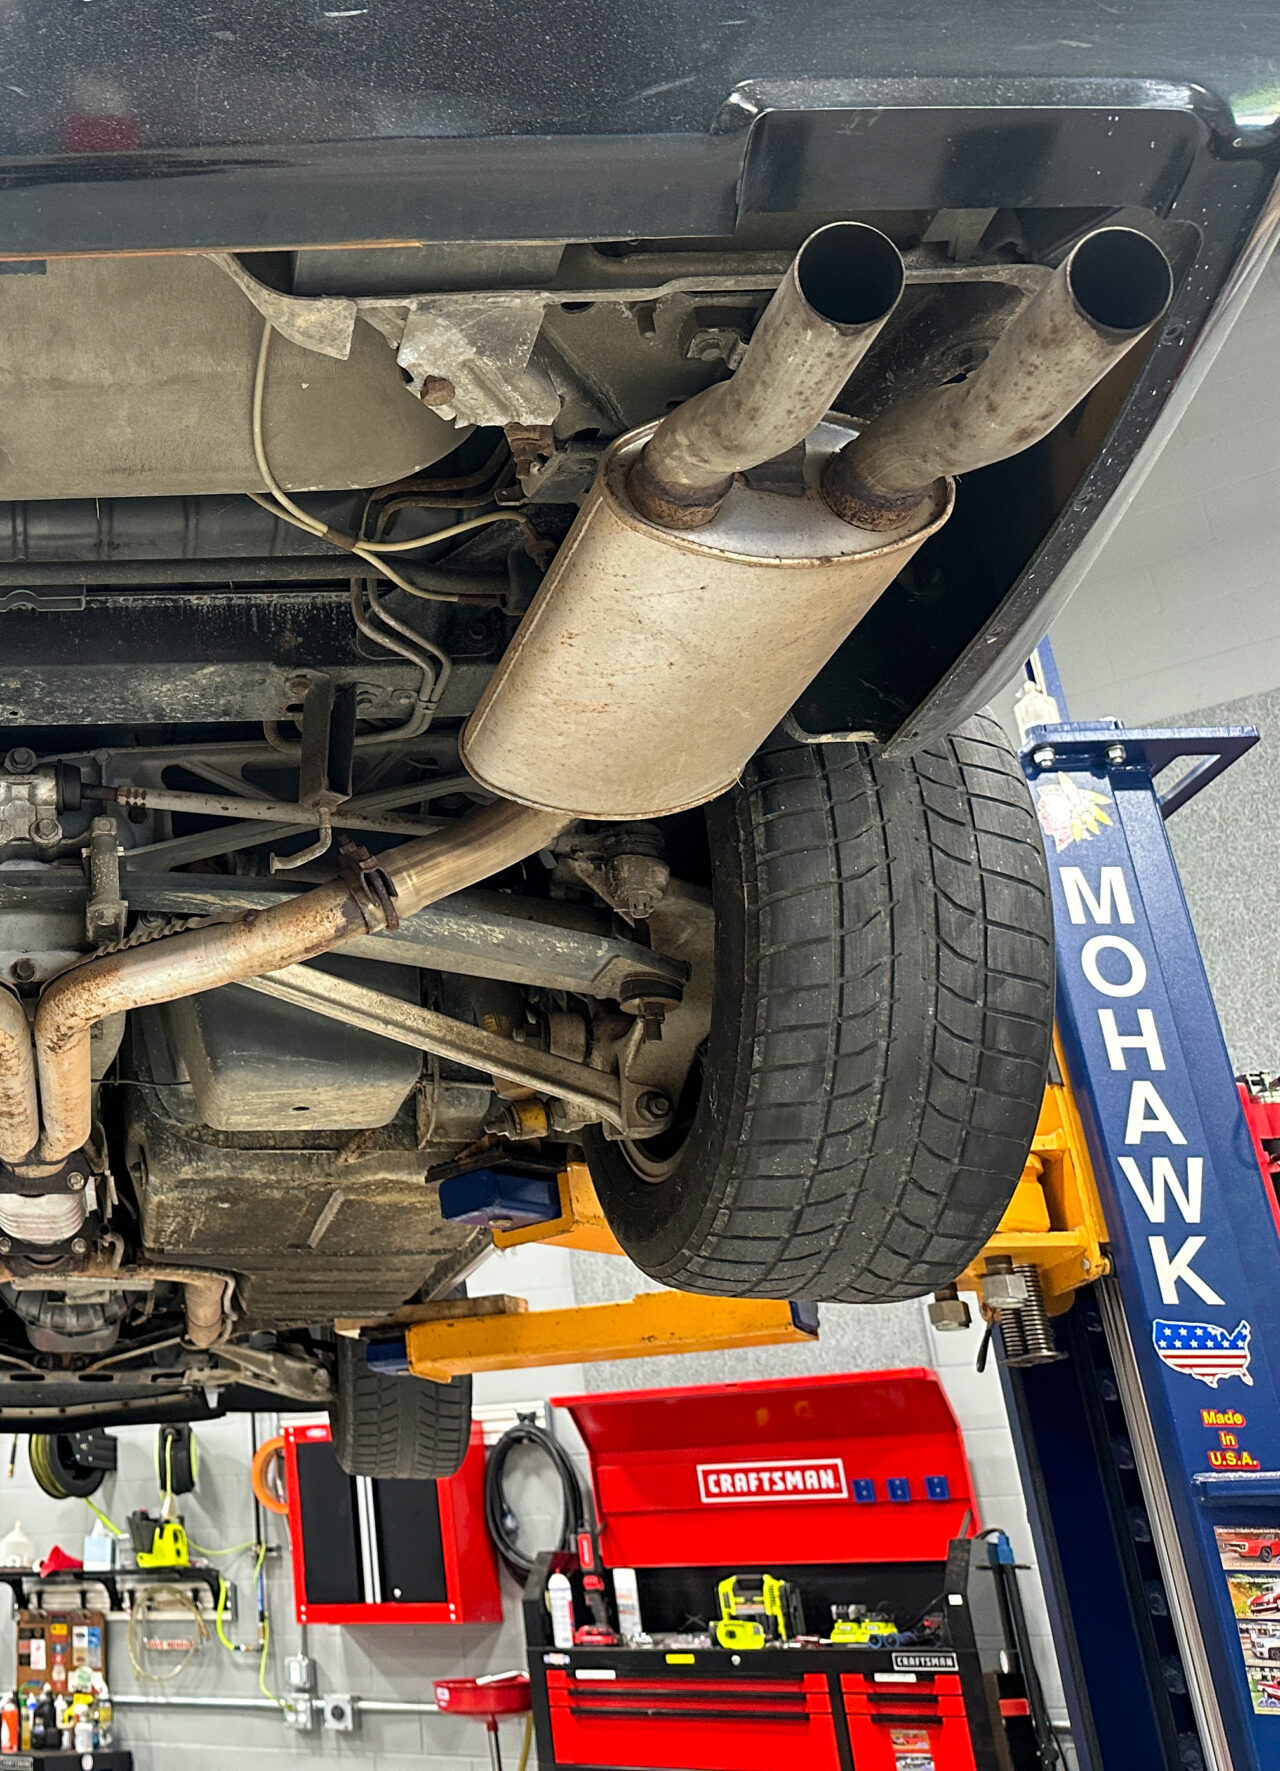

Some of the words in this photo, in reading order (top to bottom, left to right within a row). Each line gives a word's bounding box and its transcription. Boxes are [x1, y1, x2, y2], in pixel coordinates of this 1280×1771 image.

[1058, 866, 1225, 1305] MOHAWK
[1201, 1410, 1244, 1425] Made
[1208, 1451, 1258, 1466] U.S.A.
[707, 1468, 836, 1494] CRAFTSMAN
[896, 1656, 954, 1667] CRAFTSMAN
